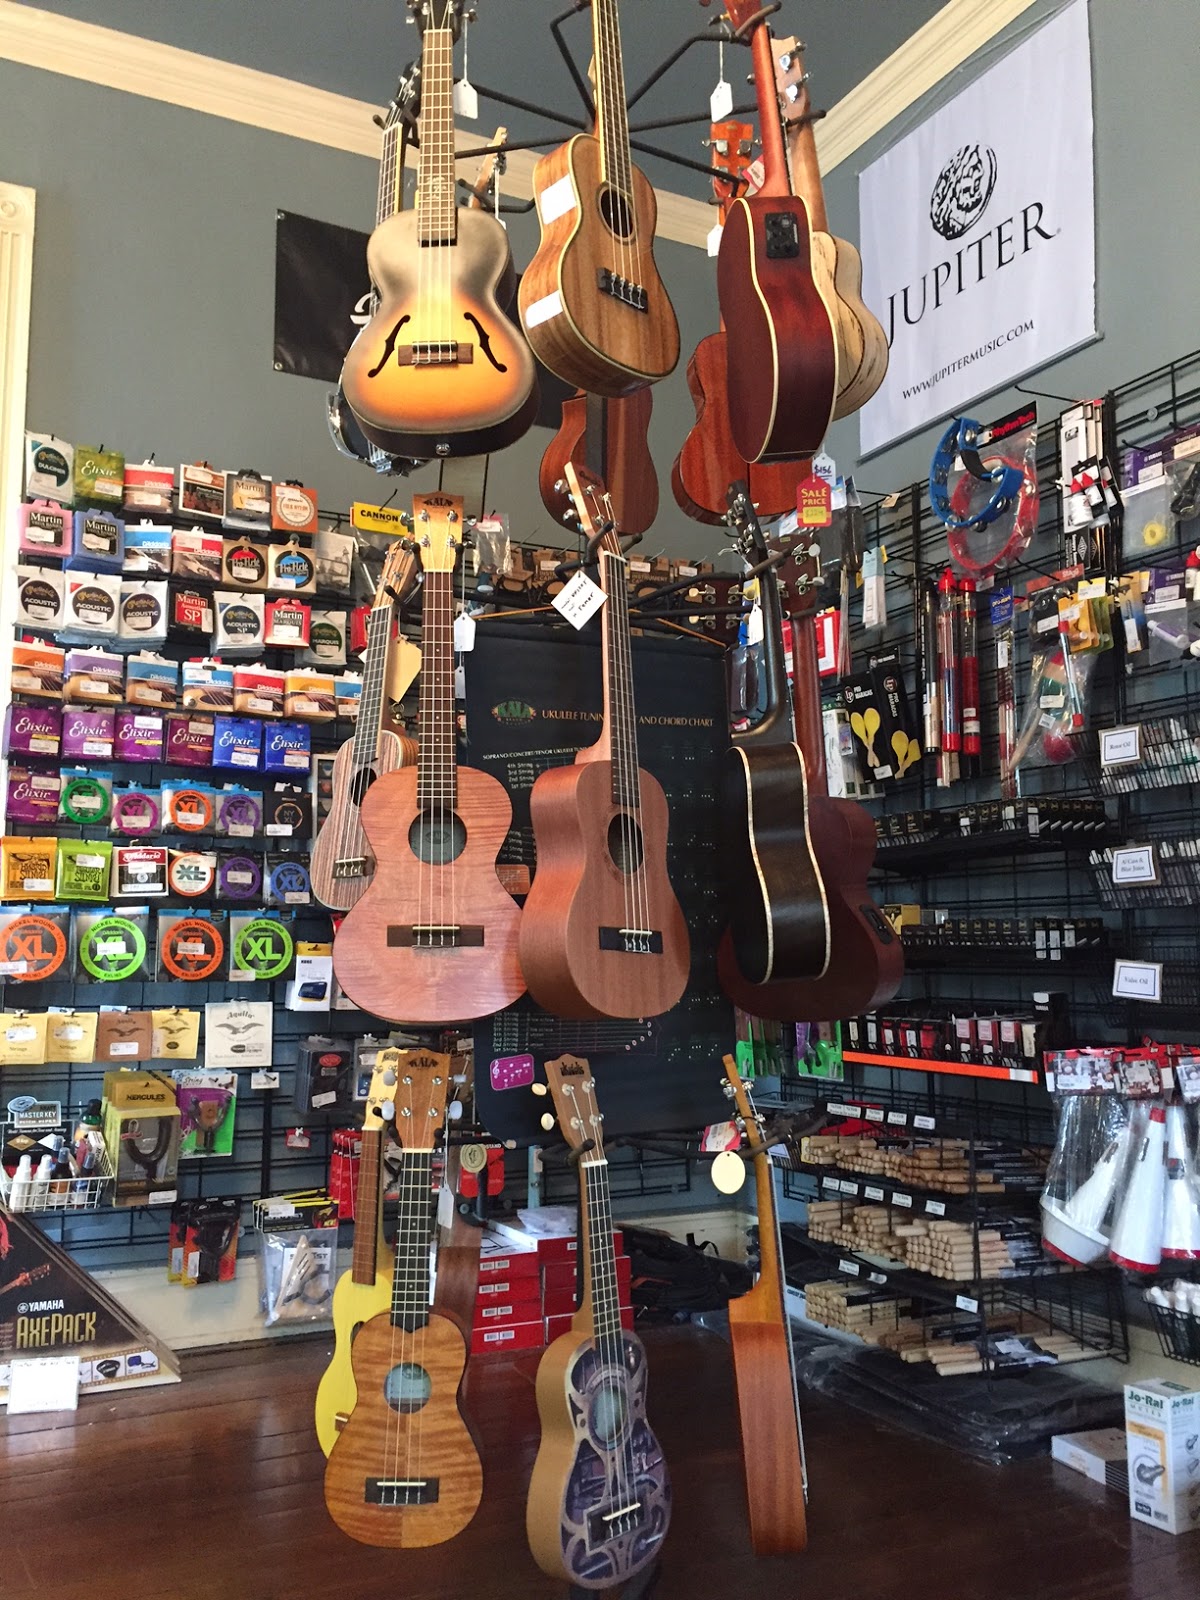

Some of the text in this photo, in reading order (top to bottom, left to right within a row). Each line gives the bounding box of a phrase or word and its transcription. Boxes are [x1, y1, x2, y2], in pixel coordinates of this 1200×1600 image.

[887, 201, 1057, 350] JUPITER
[81, 460, 117, 477] Elixir
[235, 481, 264, 493] Martin
[801, 487, 827, 498] SALE
[30, 512, 63, 525] Martin
[360, 509, 399, 523] CANNON
[86, 519, 116, 533] Martin
[25, 597, 58, 607] ACOUSTIC
[177, 594, 206, 607] Martin
[76, 603, 111, 612] ACOUSTIC
[184, 609, 200, 620] SP
[275, 610, 303, 620] Martin
[15, 717, 52, 733] Elixir
[542, 710, 713, 727] UKULELE TUNIN AND CHORD CHART
[69, 720, 107, 737] Elixir
[119, 724, 155, 740] Elixir
[172, 728, 206, 744] Elixir
[219, 731, 254, 747] Elixir
[271, 735, 303, 750] Elixir
[13, 783, 51, 800] Elixir
[9, 919, 56, 931] NICKEL WOUND
[91, 920, 136, 932] NICKEL WOUND
[173, 921, 215, 933] NICKEL WOUND
[244, 921, 284, 933] NICKEL WOUND
[11, 935, 53, 961] XL
[246, 937, 282, 961] XL
[227, 1011, 255, 1020] Aquila
[126, 1093, 166, 1101] HERCULES
[19, 1111, 44, 1119] MASTER
[28, 1299, 64, 1312] YAMAHA
[17, 1312, 96, 1349] AXEPACK
